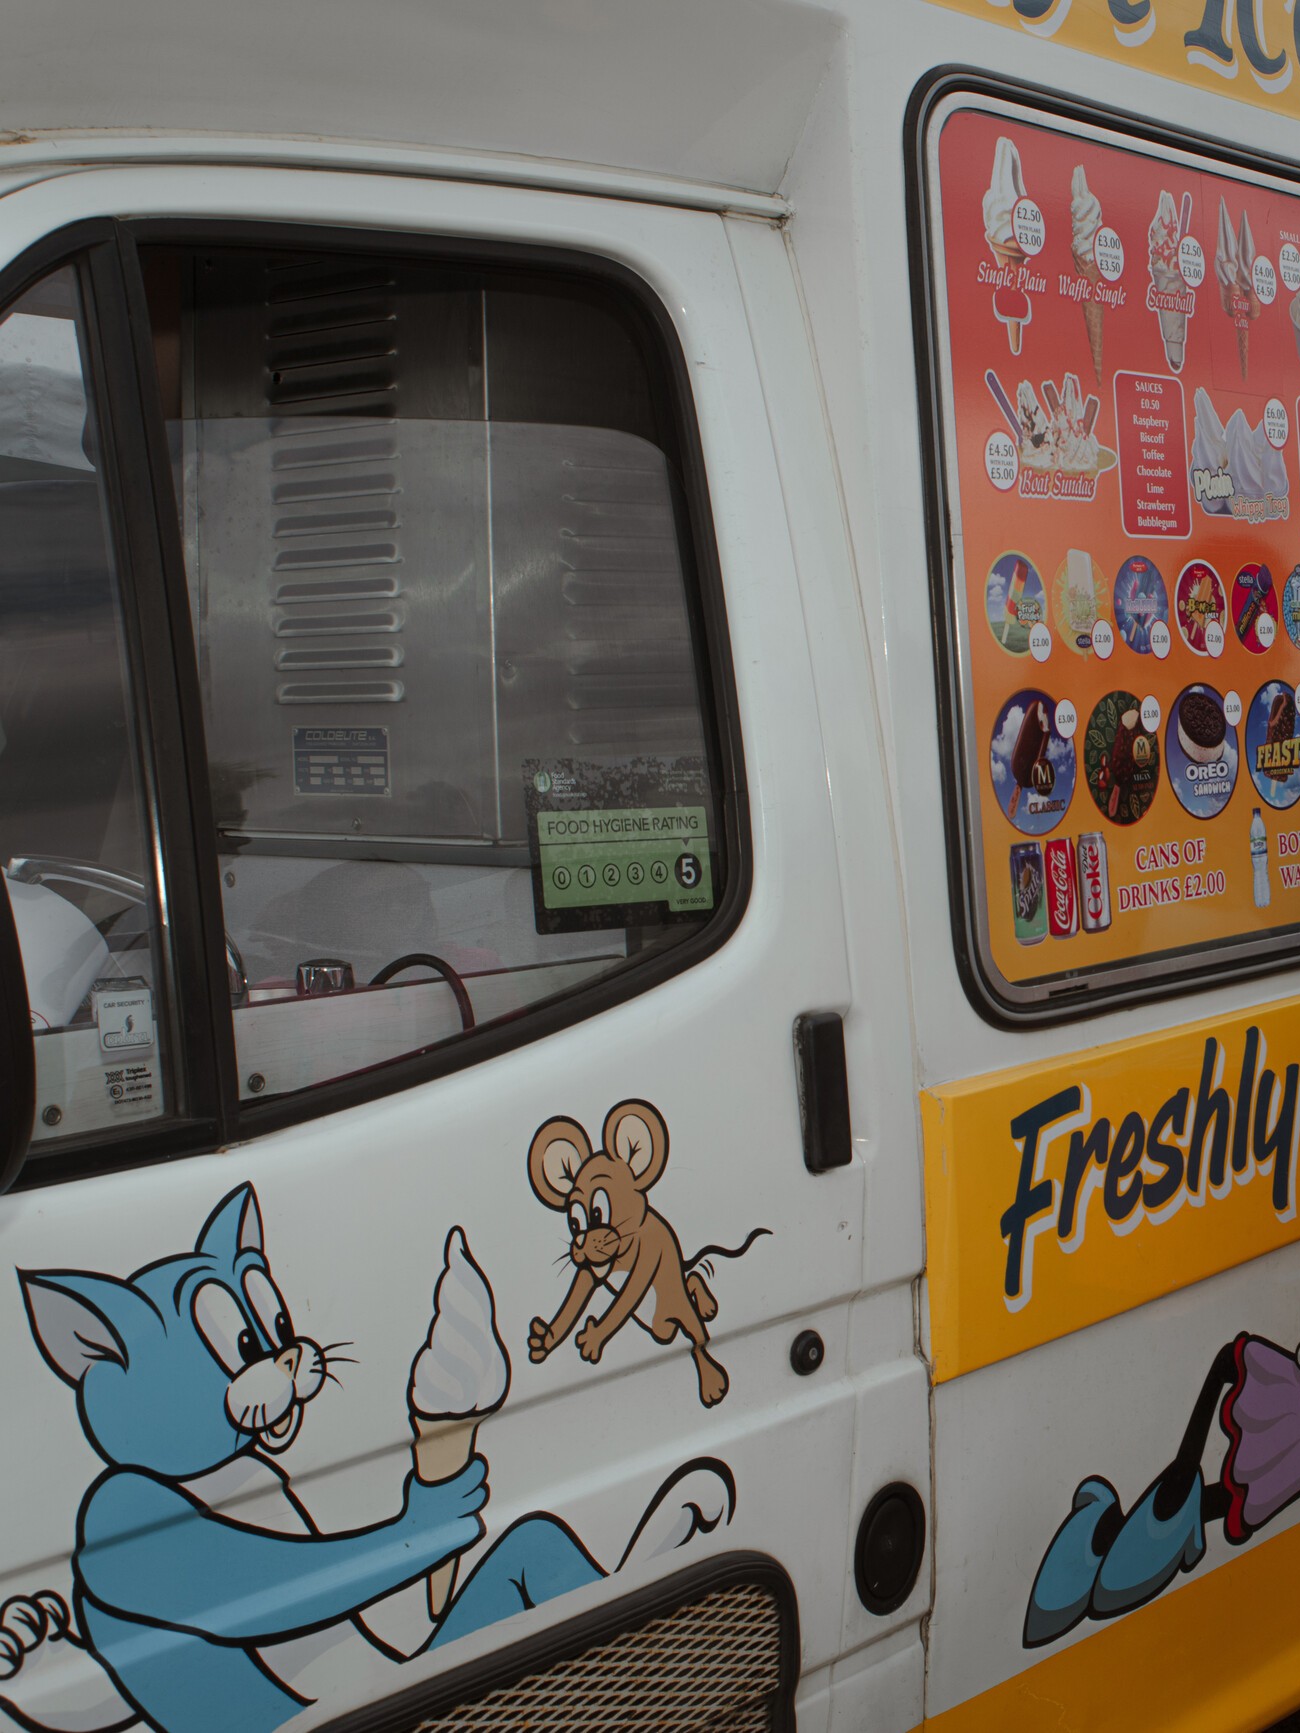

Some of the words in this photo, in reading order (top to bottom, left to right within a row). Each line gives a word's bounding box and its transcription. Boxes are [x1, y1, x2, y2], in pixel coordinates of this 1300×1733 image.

[1017, 207, 1041, 223] £2.50
[1019, 232, 1042, 247] £3.00
[1098, 235, 1121, 250] £3.00
[1279, 230, 1300, 244] SMALL
[1181, 243, 1202, 258] £2.50
[1281, 250, 1300, 264] £2.50
[1100, 261, 1121, 277] £3.50
[1183, 266, 1202, 280] £3.00
[1254, 264, 1274, 279] £4.00
[977, 262, 1013, 290] Single
[1017, 267, 1047, 293] Plain
[1283, 271, 1300, 285] £3.00
[1058, 274, 1091, 301] Waffle
[1095, 282, 1127, 309] Single
[1256, 285, 1275, 299] £4.50
[1148, 289, 1194, 313] Screwball
[1135, 380, 1163, 394] SAUCES
[1140, 400, 1160, 411] £0.50
[1266, 407, 1286, 420] £6.00
[1133, 415, 1170, 431] Raspberry
[1140, 432, 1166, 445] Biscoff
[1268, 428, 1286, 441] £7.00
[988, 443, 1015, 457] £4.50
[1142, 448, 1165, 461] Toffee
[991, 467, 1015, 481] £5.00
[1136, 465, 1172, 478] Chocolate
[1021, 470, 1050, 495] Boat
[1052, 471, 1095, 496] Sundae
[1147, 483, 1165, 494] Lime
[1194, 468, 1235, 503] Plain
[1136, 499, 1176, 515] Strawberry
[1231, 496, 1265, 522] Whippy
[1265, 492, 1289, 519] Tray
[1137, 516, 1178, 531] Bubblegum
[1238, 574, 1254, 584] stella
[1259, 625, 1274, 635] £2.00
[1032, 638, 1049, 648] £2.00
[1095, 634, 1111, 644] £2.00
[1152, 634, 1168, 644] £2.00
[1207, 634, 1222, 643] £2.00
[1143, 709, 1159, 719] £3.00
[1226, 703, 1241, 713] £3.00
[1057, 713, 1075, 724] £3.00
[1035, 763, 1051, 785] M
[1186, 763, 1228, 780] OREO
[1194, 781, 1231, 797] SANDWICH
[1028, 799, 1066, 815] CLASSIC
[547, 819, 589, 836] FOOD
[593, 817, 650, 834] HYGIENE
[652, 815, 699, 832] RATING
[1136, 843, 1179, 872] CANS
[1183, 839, 1205, 863] OF
[557, 871, 566, 886] 0
[607, 868, 616, 881] 2
[631, 866, 640, 881] 3
[655, 864, 663, 879] 4
[681, 857, 696, 885] 5
[1086, 844, 1104, 921] Coke
[1018, 869, 1044, 917] Sprite
[1118, 878, 1181, 911] DRINKS
[1184, 870, 1225, 898] £2.00
[676, 898, 689, 906] VERY
[690, 897, 706, 905] GOOD
[103, 1001, 116, 1009] CAR
[117, 999, 145, 1008] SECURITY
